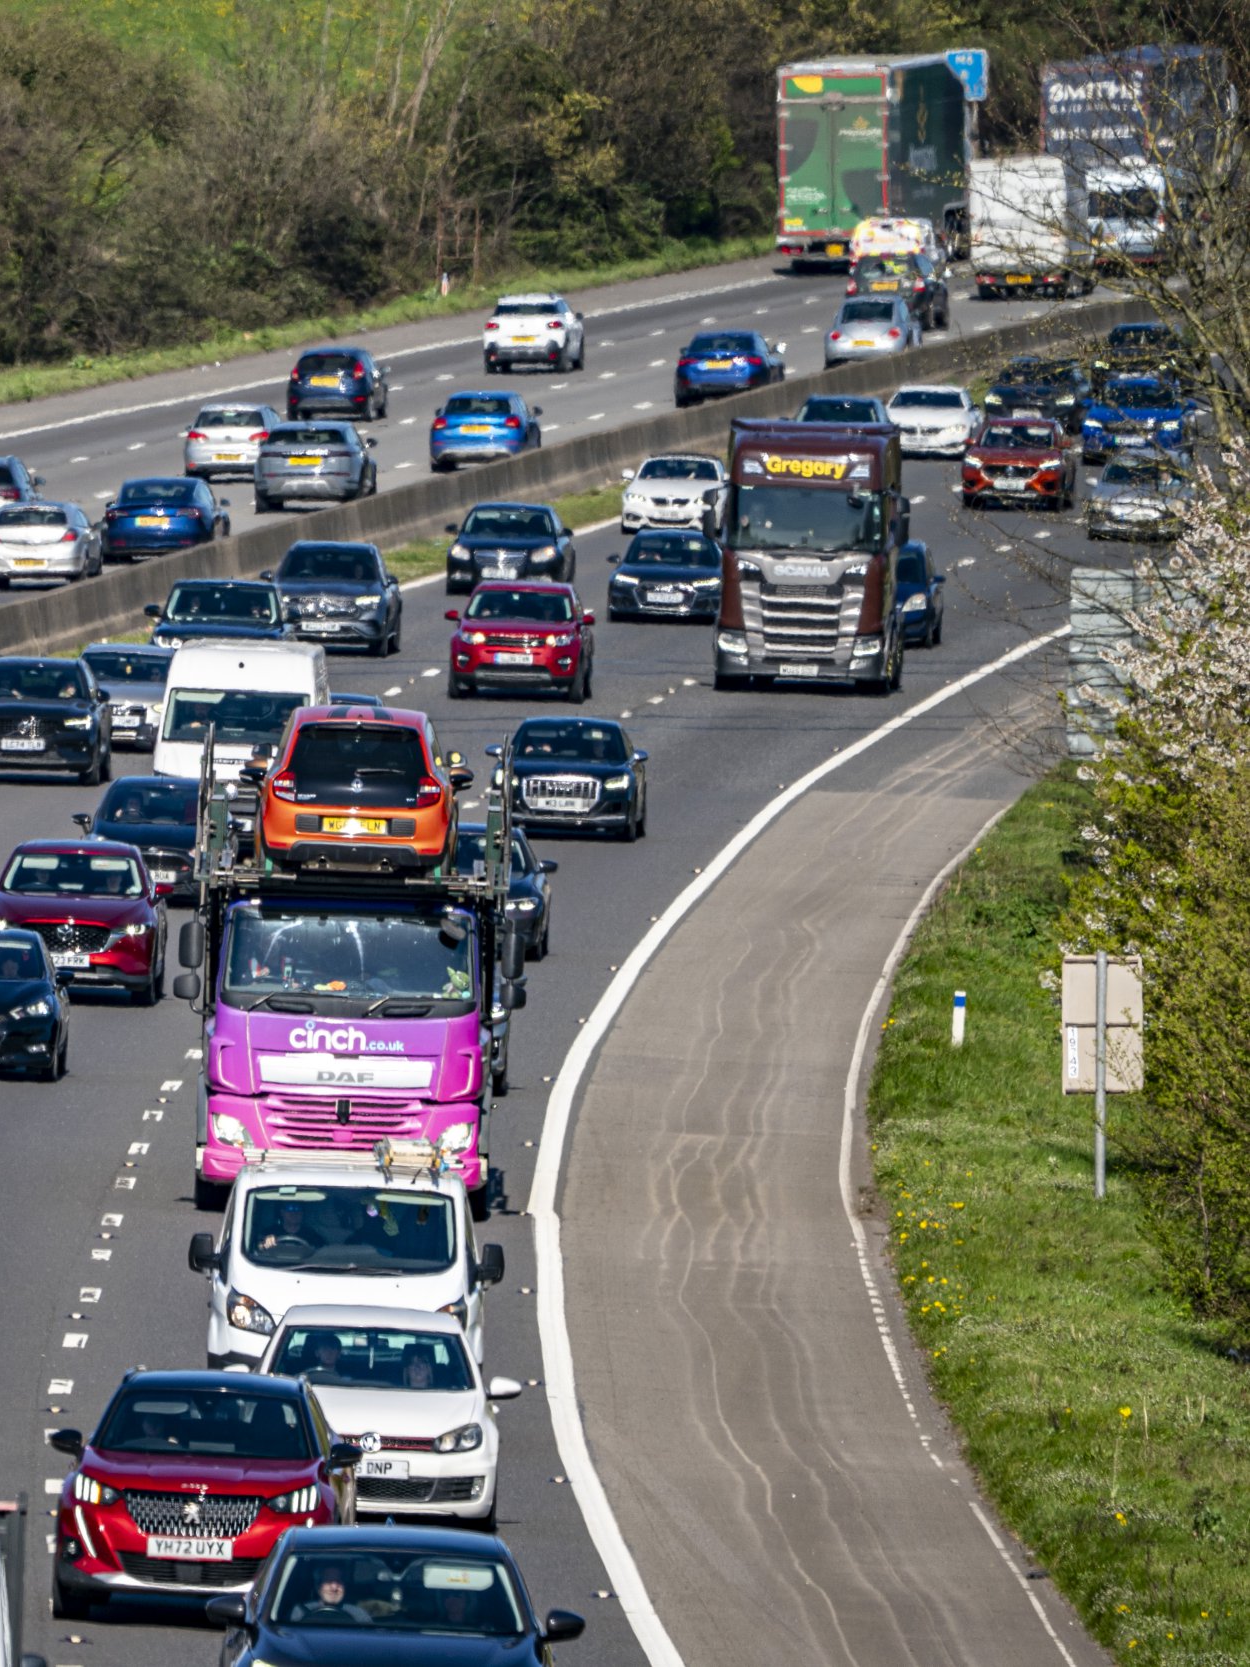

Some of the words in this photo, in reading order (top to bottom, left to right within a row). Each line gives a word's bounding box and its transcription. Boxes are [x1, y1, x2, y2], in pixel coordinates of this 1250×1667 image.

[766, 455, 847, 479] Gregory
[774, 565, 831, 577] SCANIA
[289, 1020, 405, 1052] cinch.co.uk
[317, 1071, 374, 1083] DAF
[367, 1462, 392, 1474] DNP
[155, 1540, 192, 1554] YH72
[196, 1541, 225, 1555] UYX
